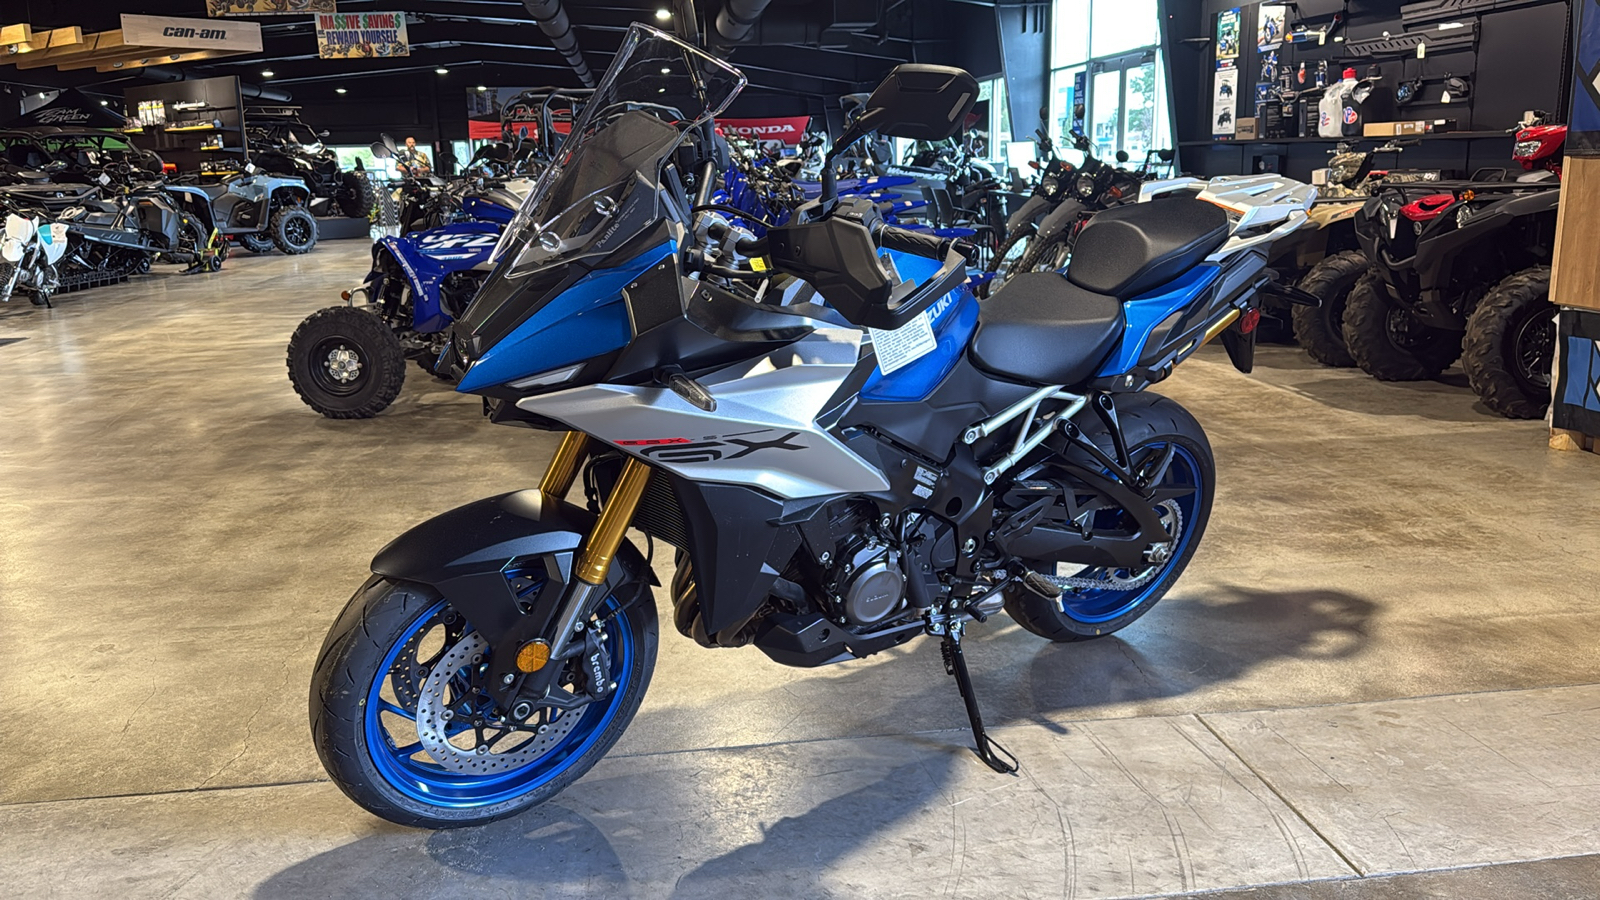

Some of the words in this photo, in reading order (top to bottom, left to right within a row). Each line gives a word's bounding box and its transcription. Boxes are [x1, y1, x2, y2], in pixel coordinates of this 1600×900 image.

[326, 31, 360, 45] REWARD
[360, 29, 398, 44] YOURSELF
[721, 124, 796, 135] HONDA
[927, 292, 953, 324] ZUKI
[590, 652, 606, 693] brembo
